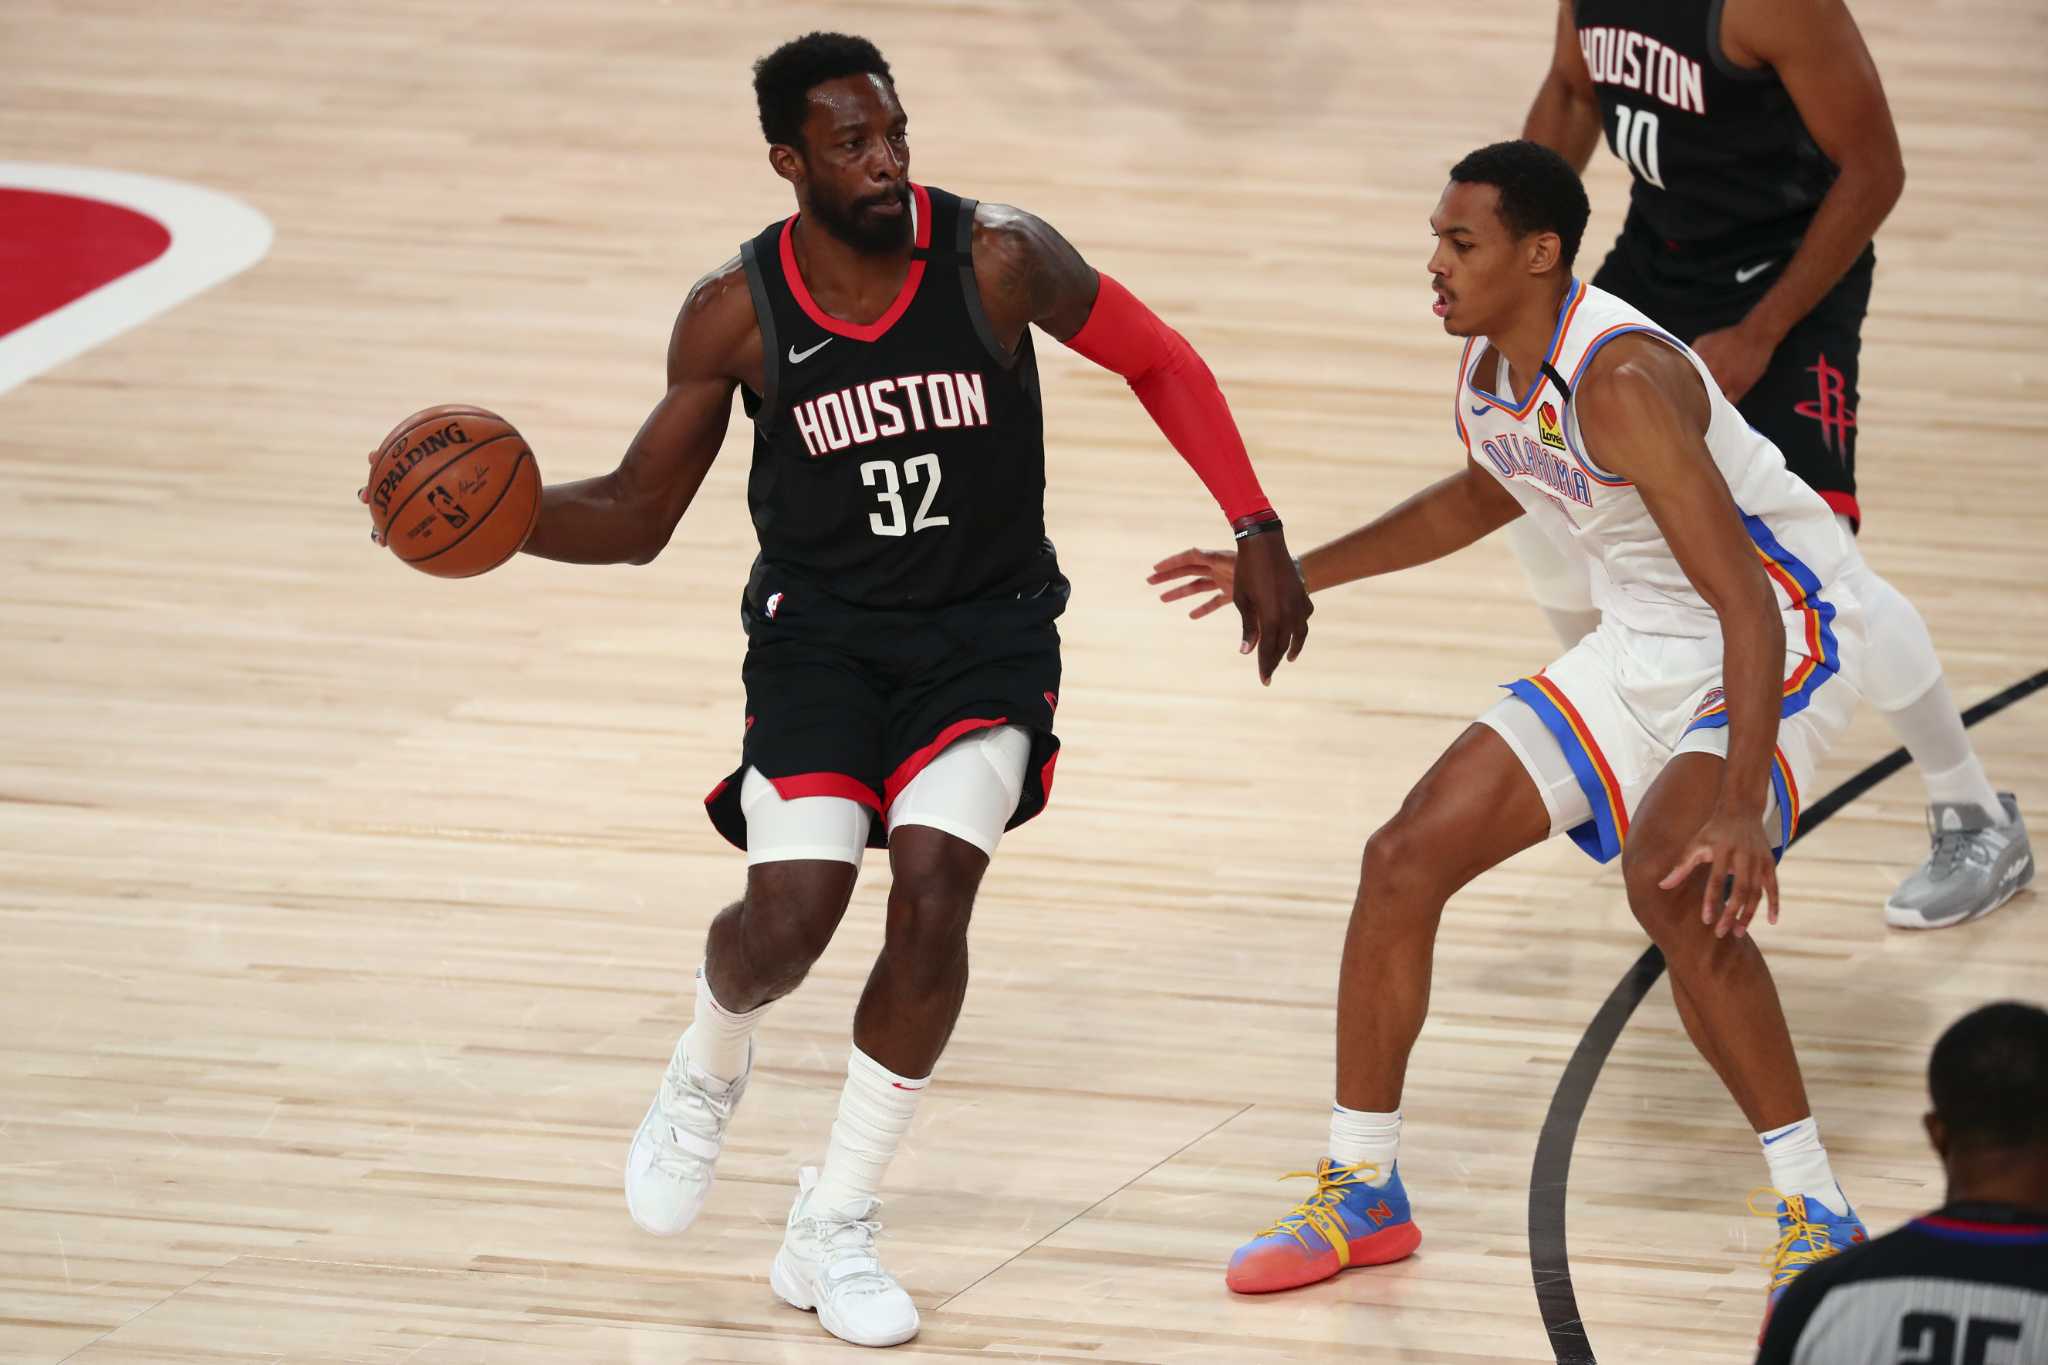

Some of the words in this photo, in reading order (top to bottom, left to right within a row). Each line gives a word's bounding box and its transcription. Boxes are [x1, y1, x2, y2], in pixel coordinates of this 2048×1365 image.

[1615, 103, 1666, 191] 10
[793, 371, 989, 456] HOUSTON
[374, 422, 470, 515] SPALDING
[859, 453, 950, 537] 32
[1482, 433, 1593, 508] OKLAHOMA
